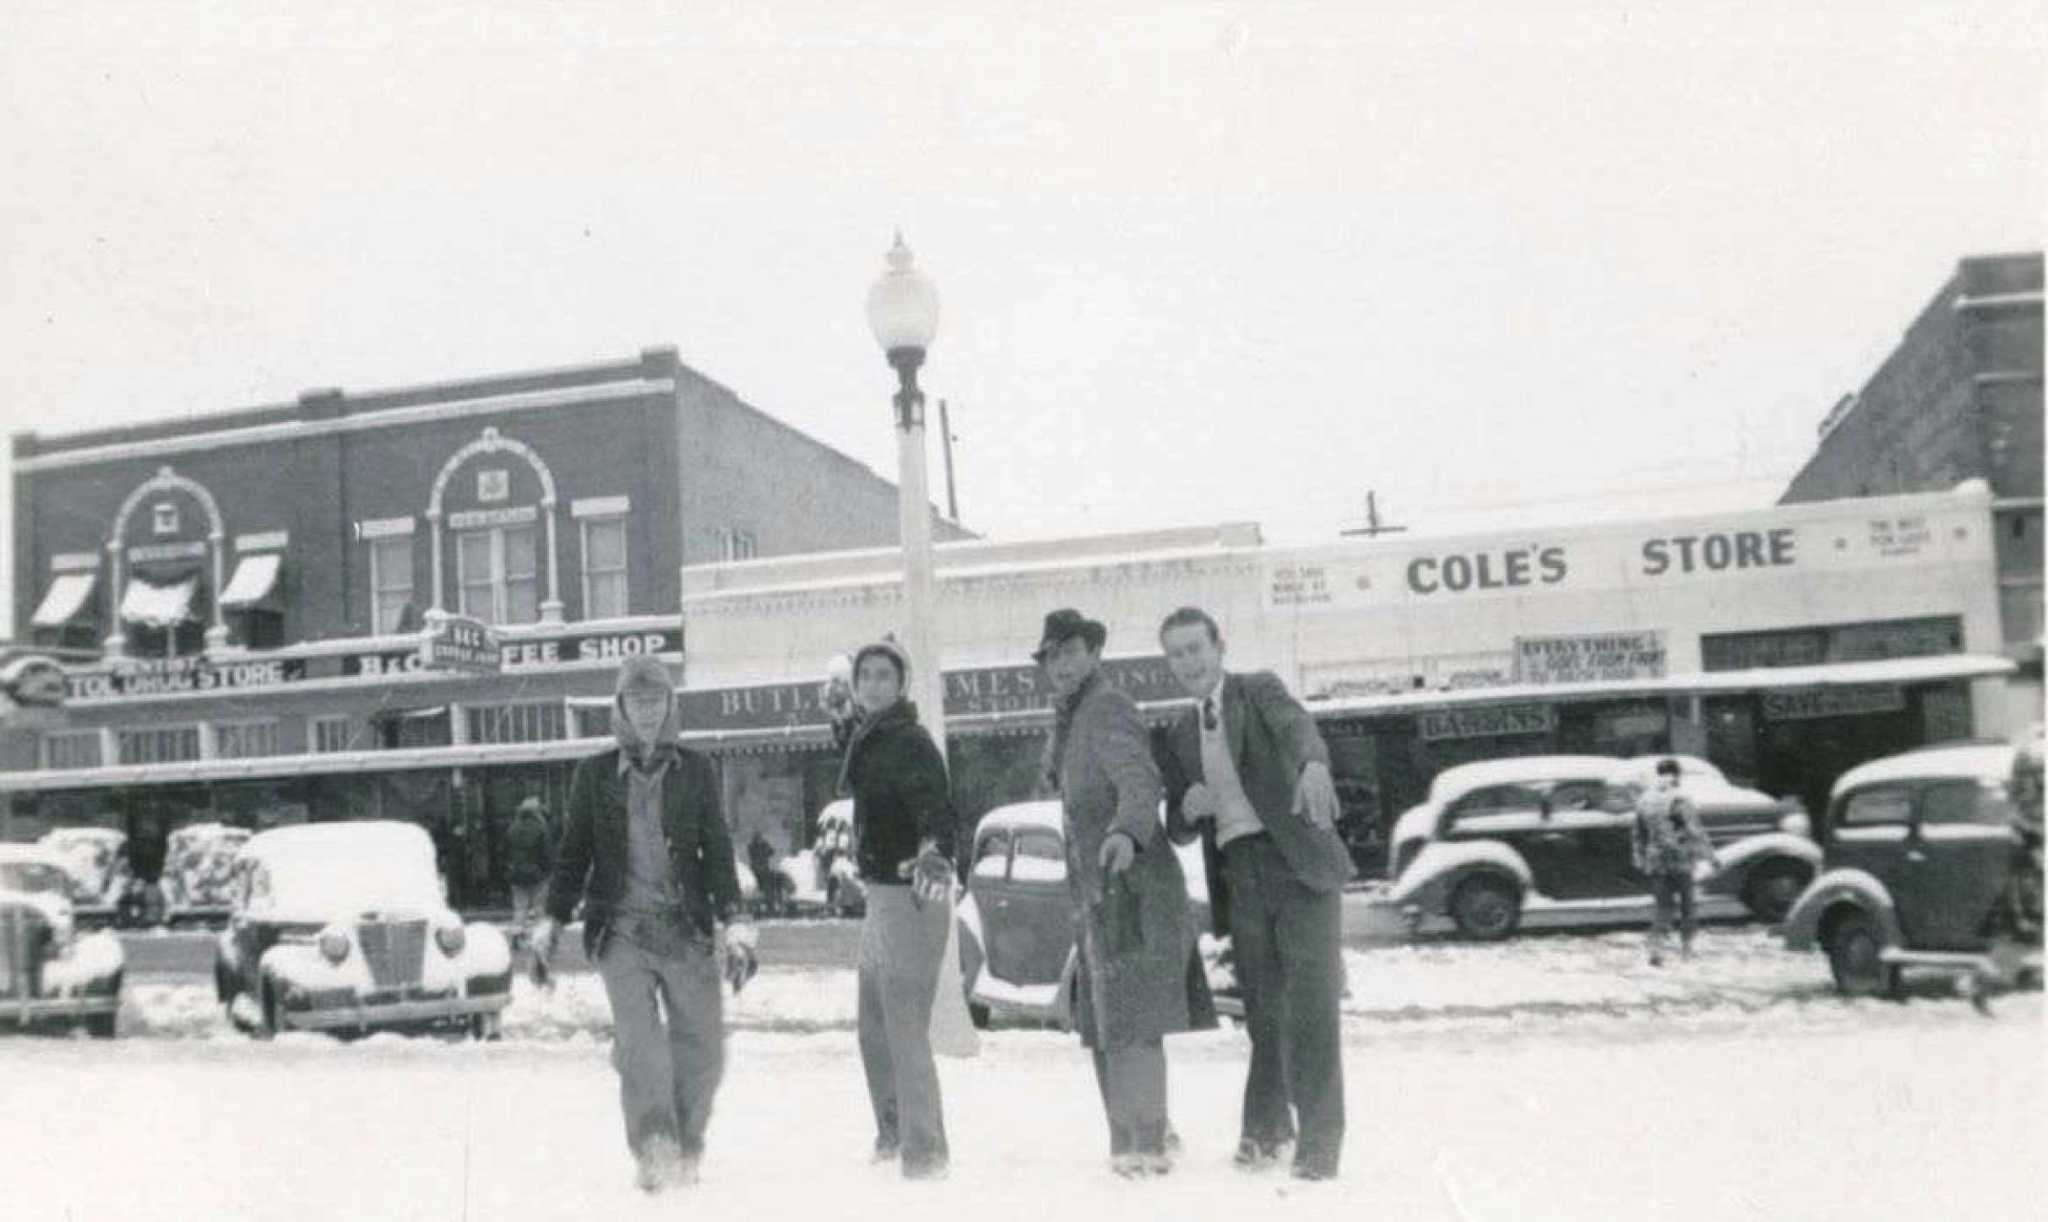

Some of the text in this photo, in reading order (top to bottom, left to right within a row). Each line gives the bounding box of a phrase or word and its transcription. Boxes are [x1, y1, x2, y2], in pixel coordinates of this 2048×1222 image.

[1406, 528, 1797, 594] COLE'S STORE
[502, 640, 562, 666] FEE
[579, 633, 668, 661] SHOP
[69, 674, 119, 698] TOL
[199, 662, 284, 690] STORE
[720, 686, 829, 716] BUTL
[944, 671, 1034, 698] MES
